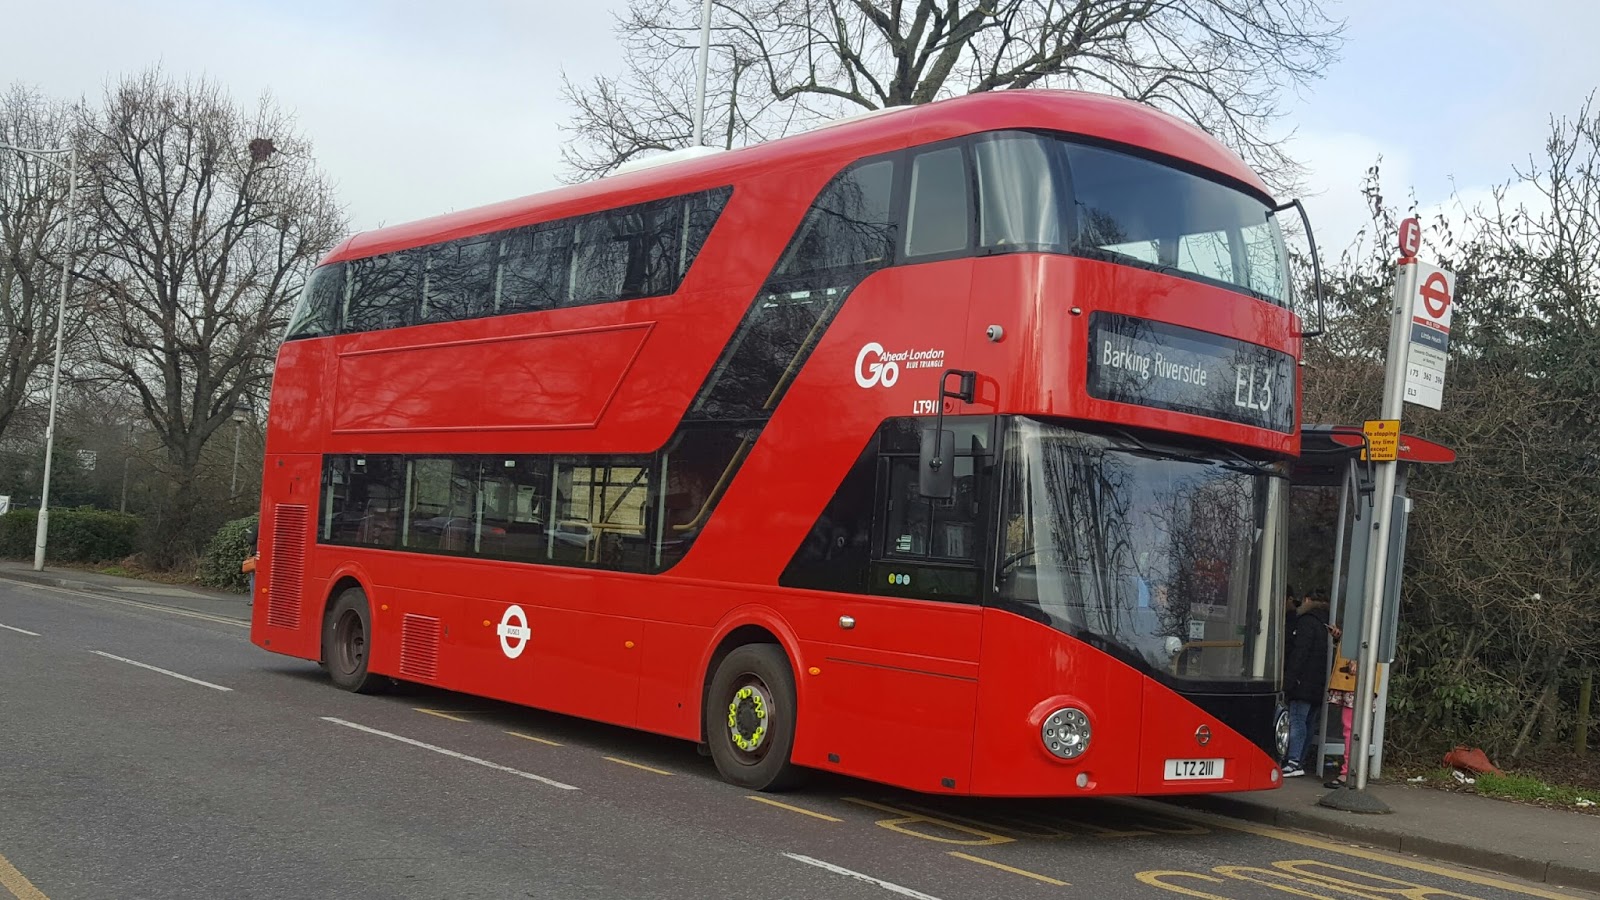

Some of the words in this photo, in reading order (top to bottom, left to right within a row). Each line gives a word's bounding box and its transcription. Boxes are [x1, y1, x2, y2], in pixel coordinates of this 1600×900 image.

[1406, 223, 1418, 251] E
[880, 348, 945, 361] Ahead-London
[855, 342, 899, 388] Go
[906, 361, 918, 369] BLUE
[919, 360, 944, 368] TRIANGLE
[1103, 340, 1150, 380] Barking
[1154, 352, 1207, 386] Riverside
[1410, 369, 1418, 377] 173
[1234, 366, 1272, 412] EL3
[1408, 388, 1416, 396] EL3
[913, 400, 939, 414] LT911
[1175, 761, 1196, 777] LTZ
[1198, 760, 1215, 776] 2111
